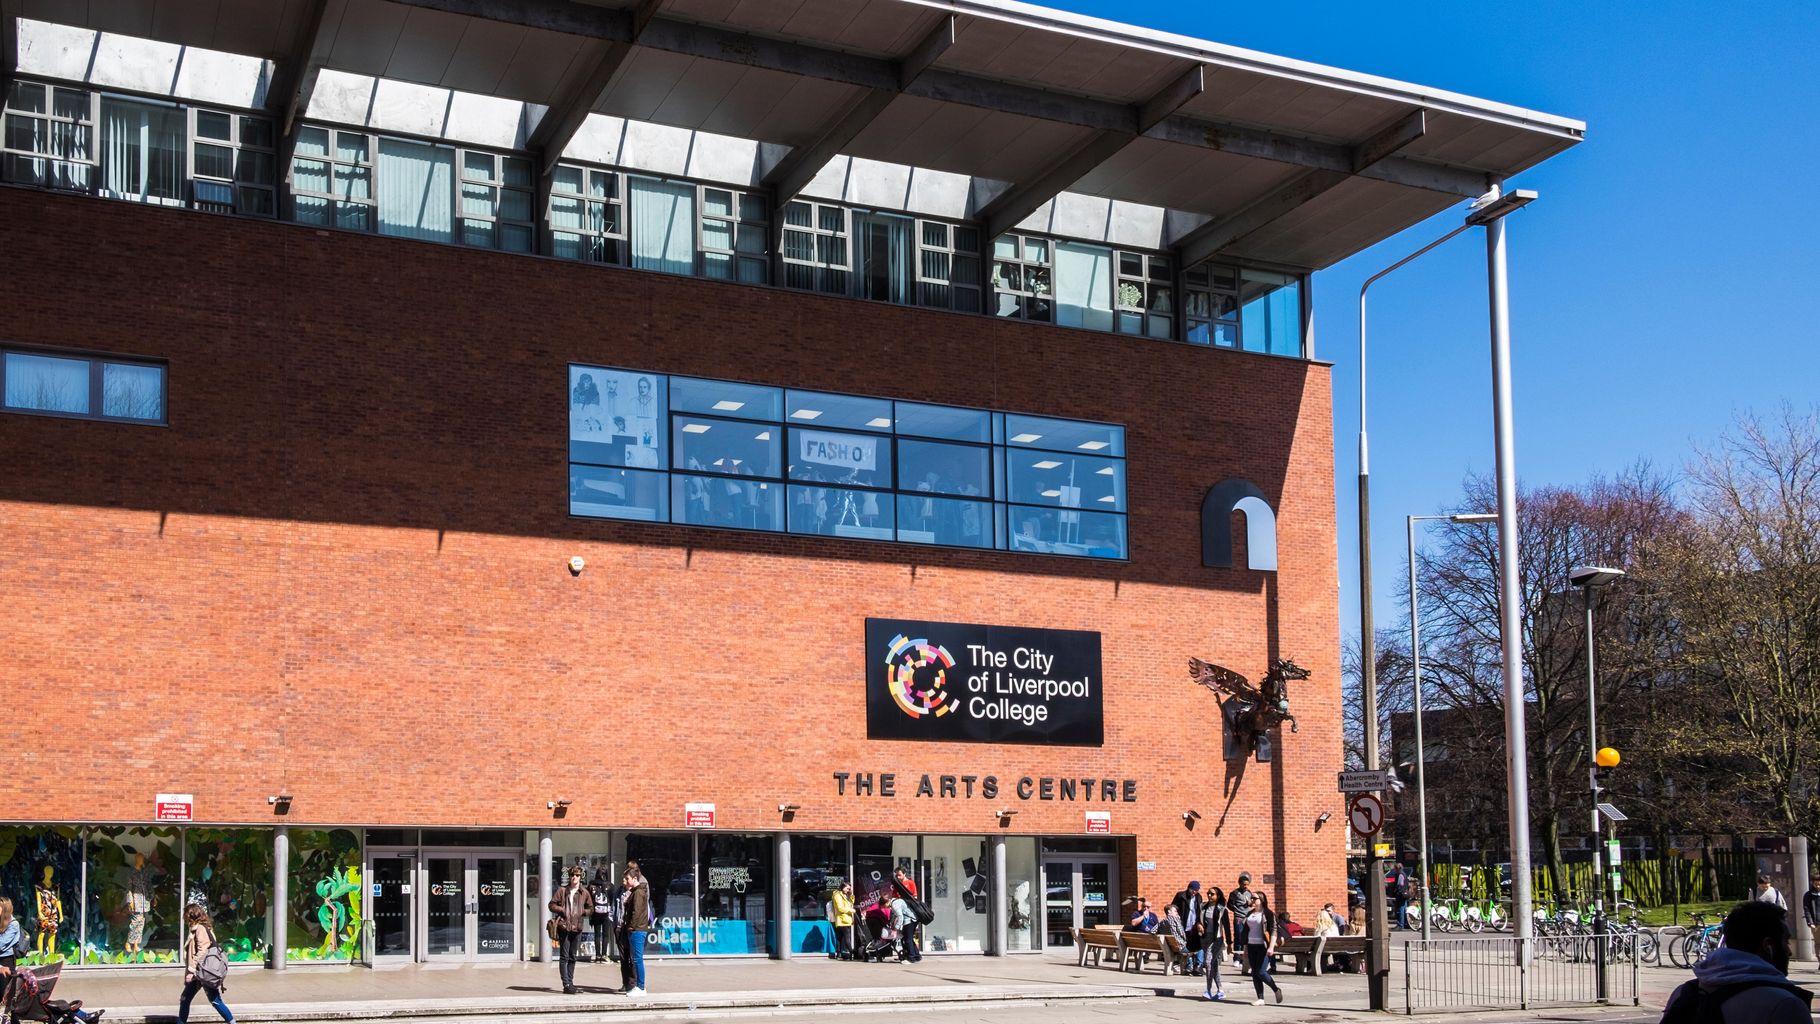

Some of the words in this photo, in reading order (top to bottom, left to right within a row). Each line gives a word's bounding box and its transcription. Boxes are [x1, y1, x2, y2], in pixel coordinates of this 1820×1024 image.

[967, 645, 1007, 668] The
[1013, 647, 1054, 675] City
[968, 671, 989, 692] of
[996, 672, 1089, 701] Liverpool
[969, 697, 1048, 726] College
[833, 772, 896, 797] THE
[916, 774, 999, 799] ARTS
[1017, 777, 1137, 802] CENTRE
[661, 916, 718, 929] ONLINE
